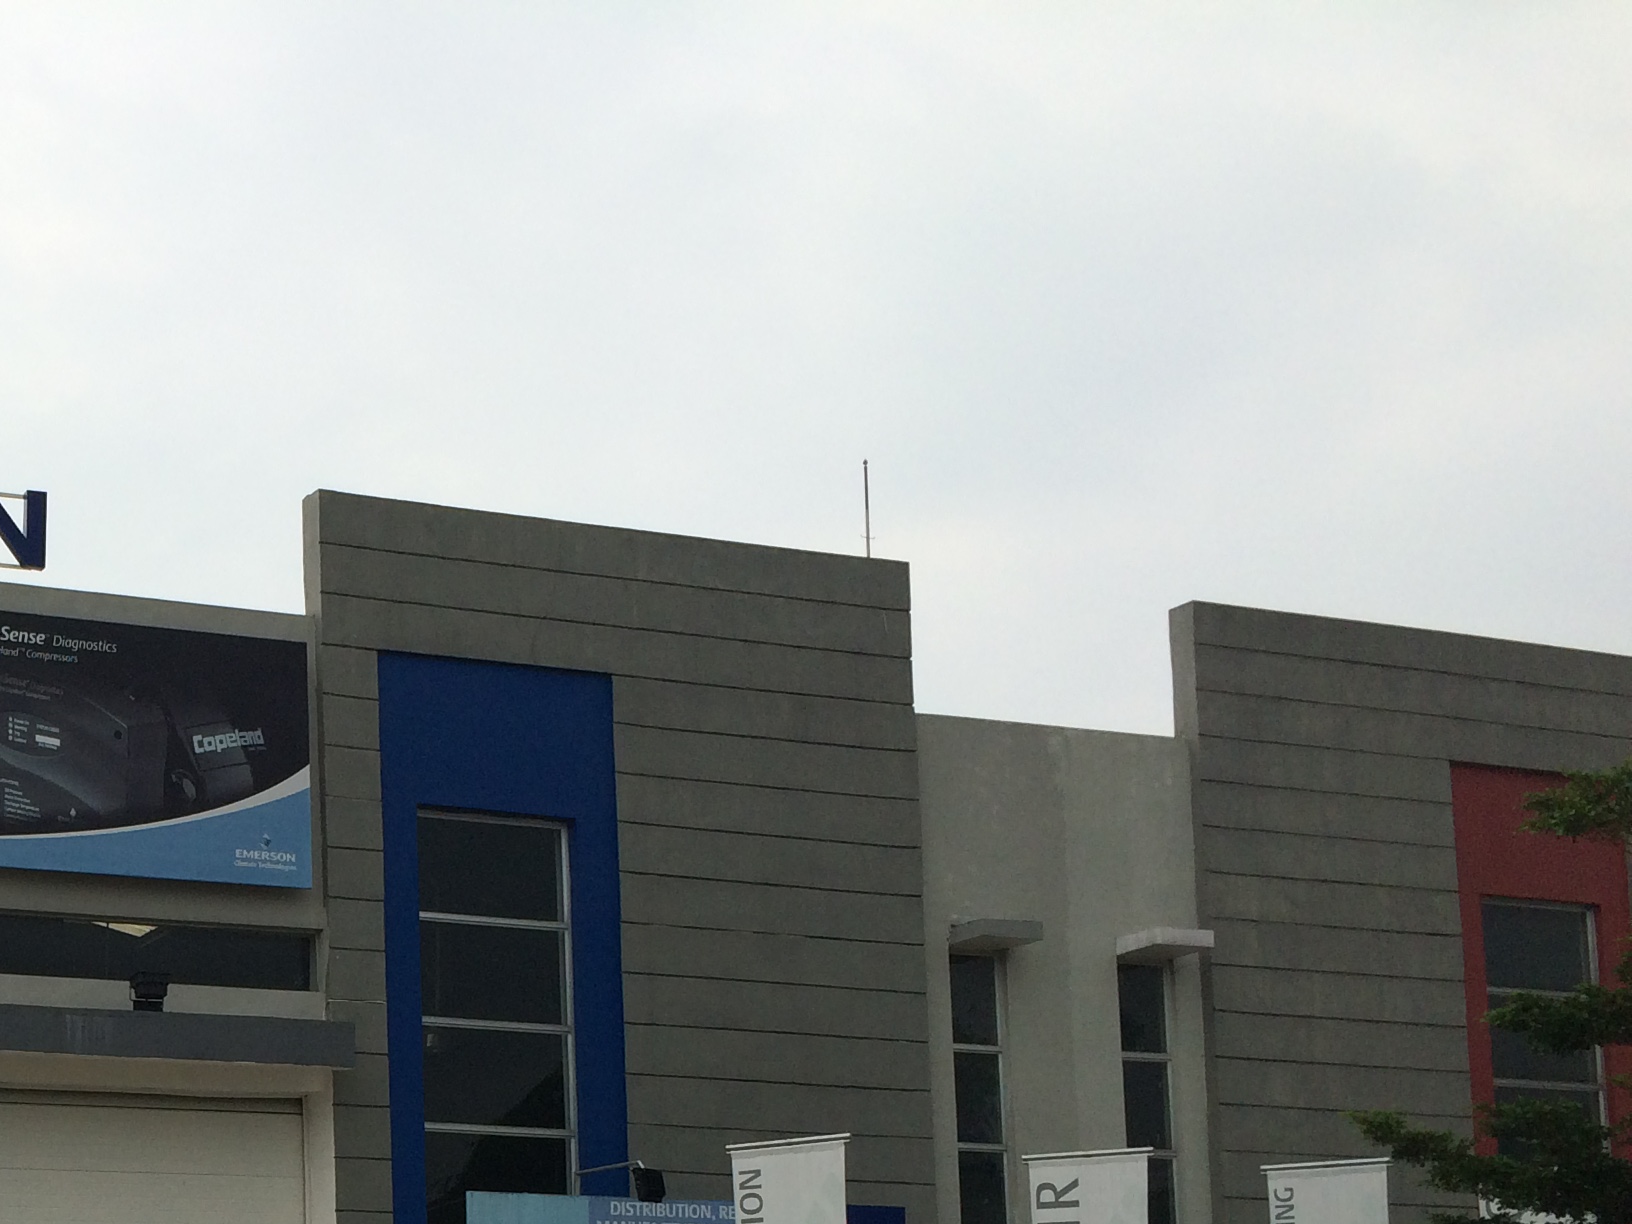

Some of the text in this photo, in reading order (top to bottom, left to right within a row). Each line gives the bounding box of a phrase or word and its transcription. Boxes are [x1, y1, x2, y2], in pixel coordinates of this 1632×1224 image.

[52, 634, 118, 654] Diagnostics
[26, 648, 79, 663] Compressors
[192, 727, 265, 754] Copeland
[235, 848, 297, 863] EMERSON
[610, 1201, 717, 1221] DISTRIBUTION,
